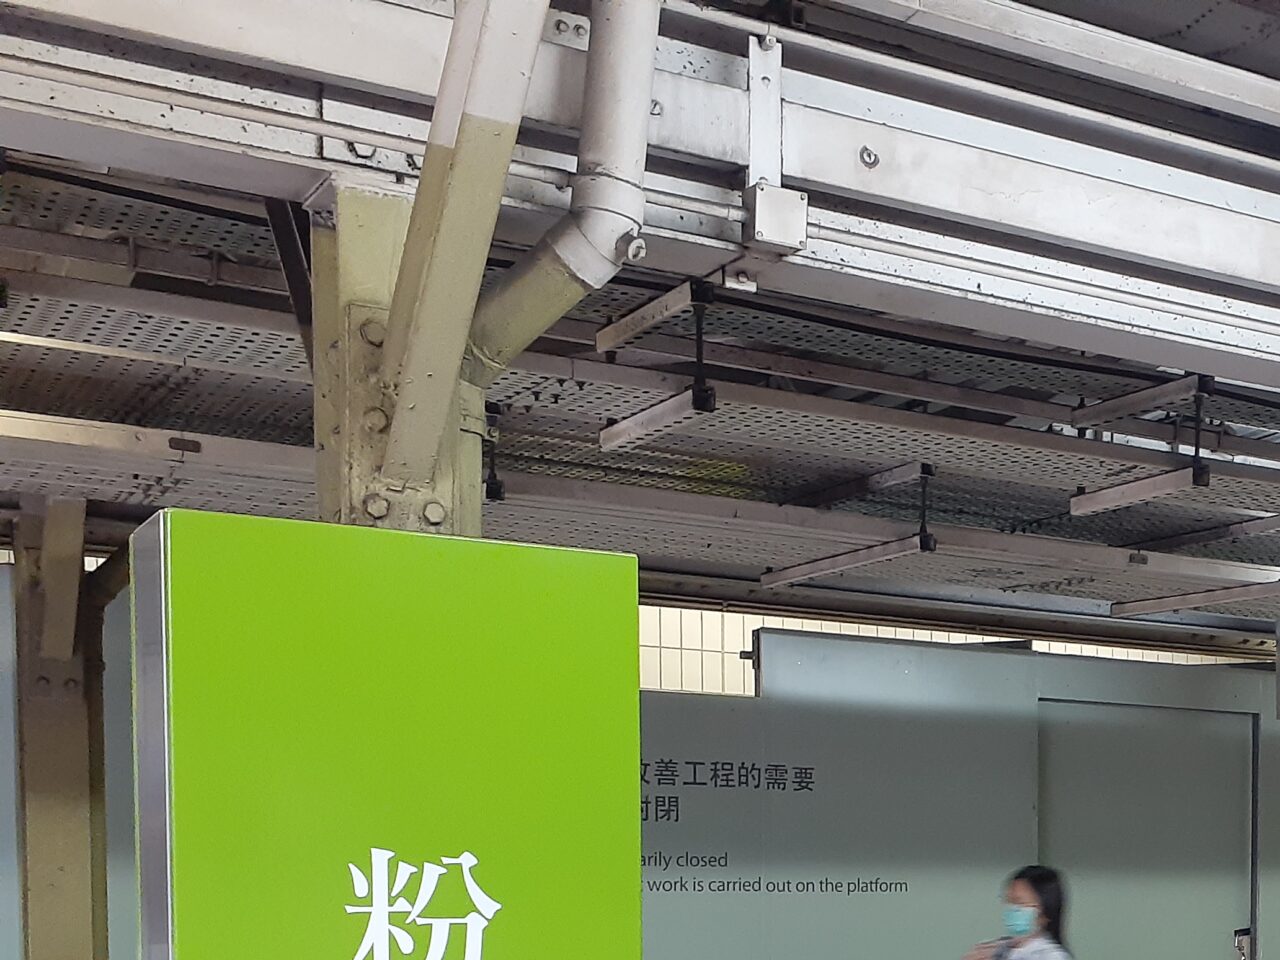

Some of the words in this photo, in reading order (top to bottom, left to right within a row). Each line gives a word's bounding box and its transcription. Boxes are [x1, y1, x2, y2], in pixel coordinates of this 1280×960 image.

[676, 851, 728, 868] closed
[647, 876, 689, 892] work
[693, 876, 705, 892] is
[708, 876, 762, 892] carried
[765, 879, 792, 893] out
[795, 881, 815, 893] on
[819, 877, 844, 893] the
[847, 877, 909, 896] platform
